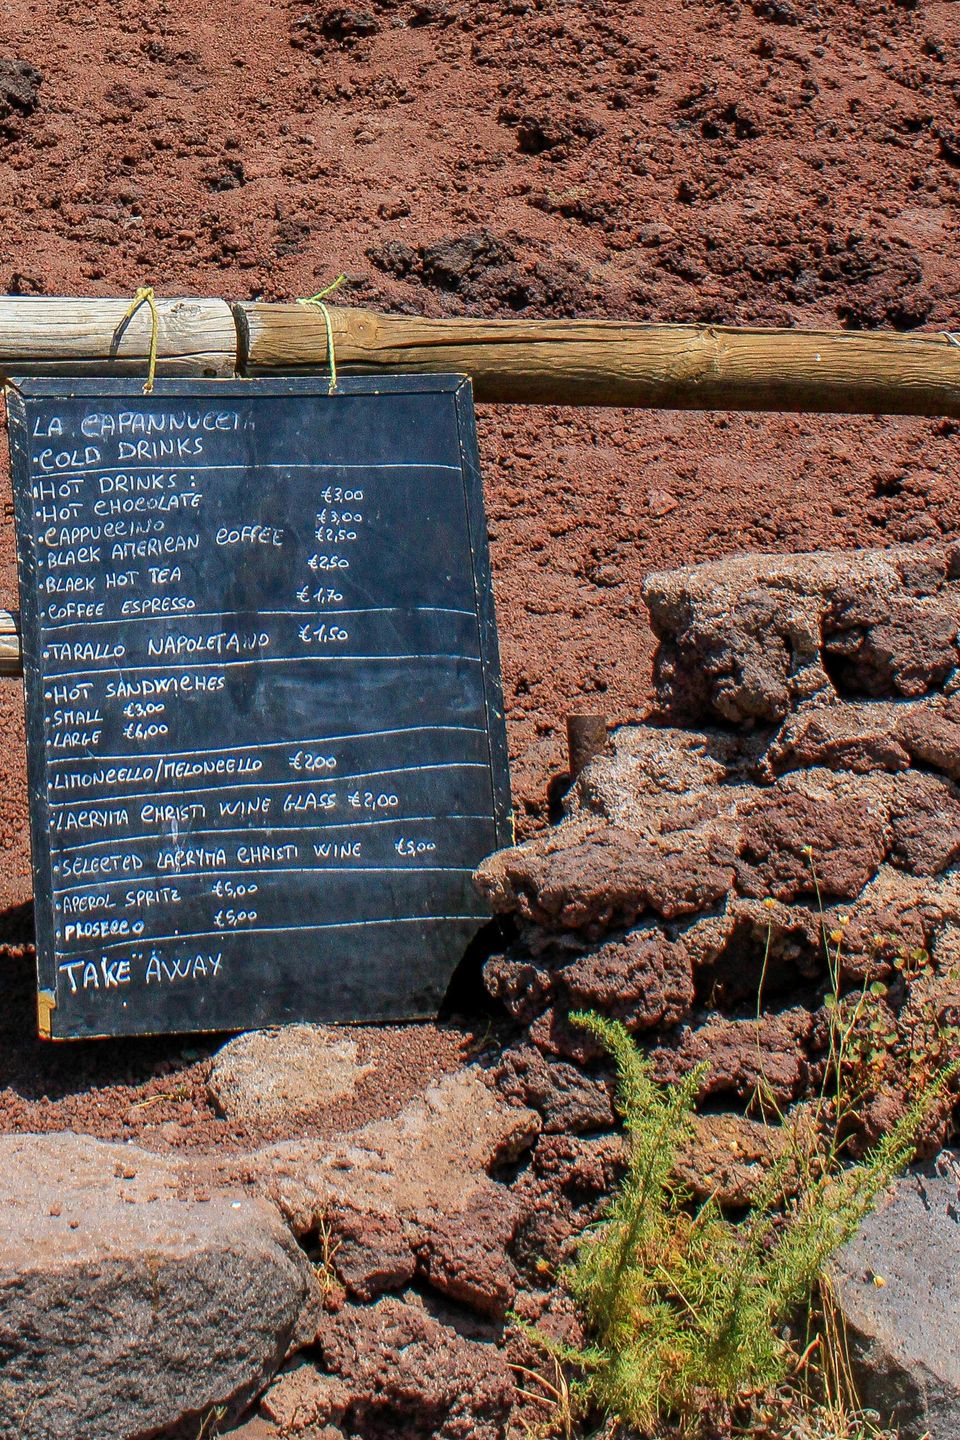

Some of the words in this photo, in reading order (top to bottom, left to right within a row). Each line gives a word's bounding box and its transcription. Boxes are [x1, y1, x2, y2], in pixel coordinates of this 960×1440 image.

[33, 417, 63, 437] LA
[40, 446, 101, 470] COLD
[118, 437, 204, 460] DRINKS
[39, 479, 84, 500] HOT
[43, 503, 84, 523] HOT
[94, 493, 202, 517] CHOCOLATE
[321, 486, 364, 503] €3,00
[45, 518, 165, 547] CAPPUCCINO
[48, 546, 101, 569] BLACK
[112, 534, 200, 561] AMERICAN
[215, 525, 284, 546] COFFEE
[46, 576, 96, 594] BLACK
[106, 571, 139, 589] HOT
[148, 566, 182, 584] TEA
[49, 602, 105, 620] COFFEE
[121, 596, 196, 615] ESPRESSO
[47, 643, 126, 661] TARALLO
[148, 633, 270, 656] NAPOLETANO
[54, 683, 93, 704] HOT
[105, 675, 225, 698] SANDWICHES
[52, 710, 103, 726] SMALL
[54, 730, 102, 748] LARGE
[56, 809, 129, 831] LACRYMA
[140, 804, 206, 824] CHRISTI
[219, 796, 272, 816] WINE
[283, 792, 336, 811] GLASS
[347, 790, 399, 810] €2,00
[62, 854, 143, 878] SELECTED
[237, 844, 299, 864] CHRISTI
[313, 842, 362, 858] WINE
[63, 895, 116, 914] APEROL
[124, 887, 182, 908] SPRITZ
[64, 919, 145, 941] PROSECCO
[58, 957, 132, 993] TAKE
